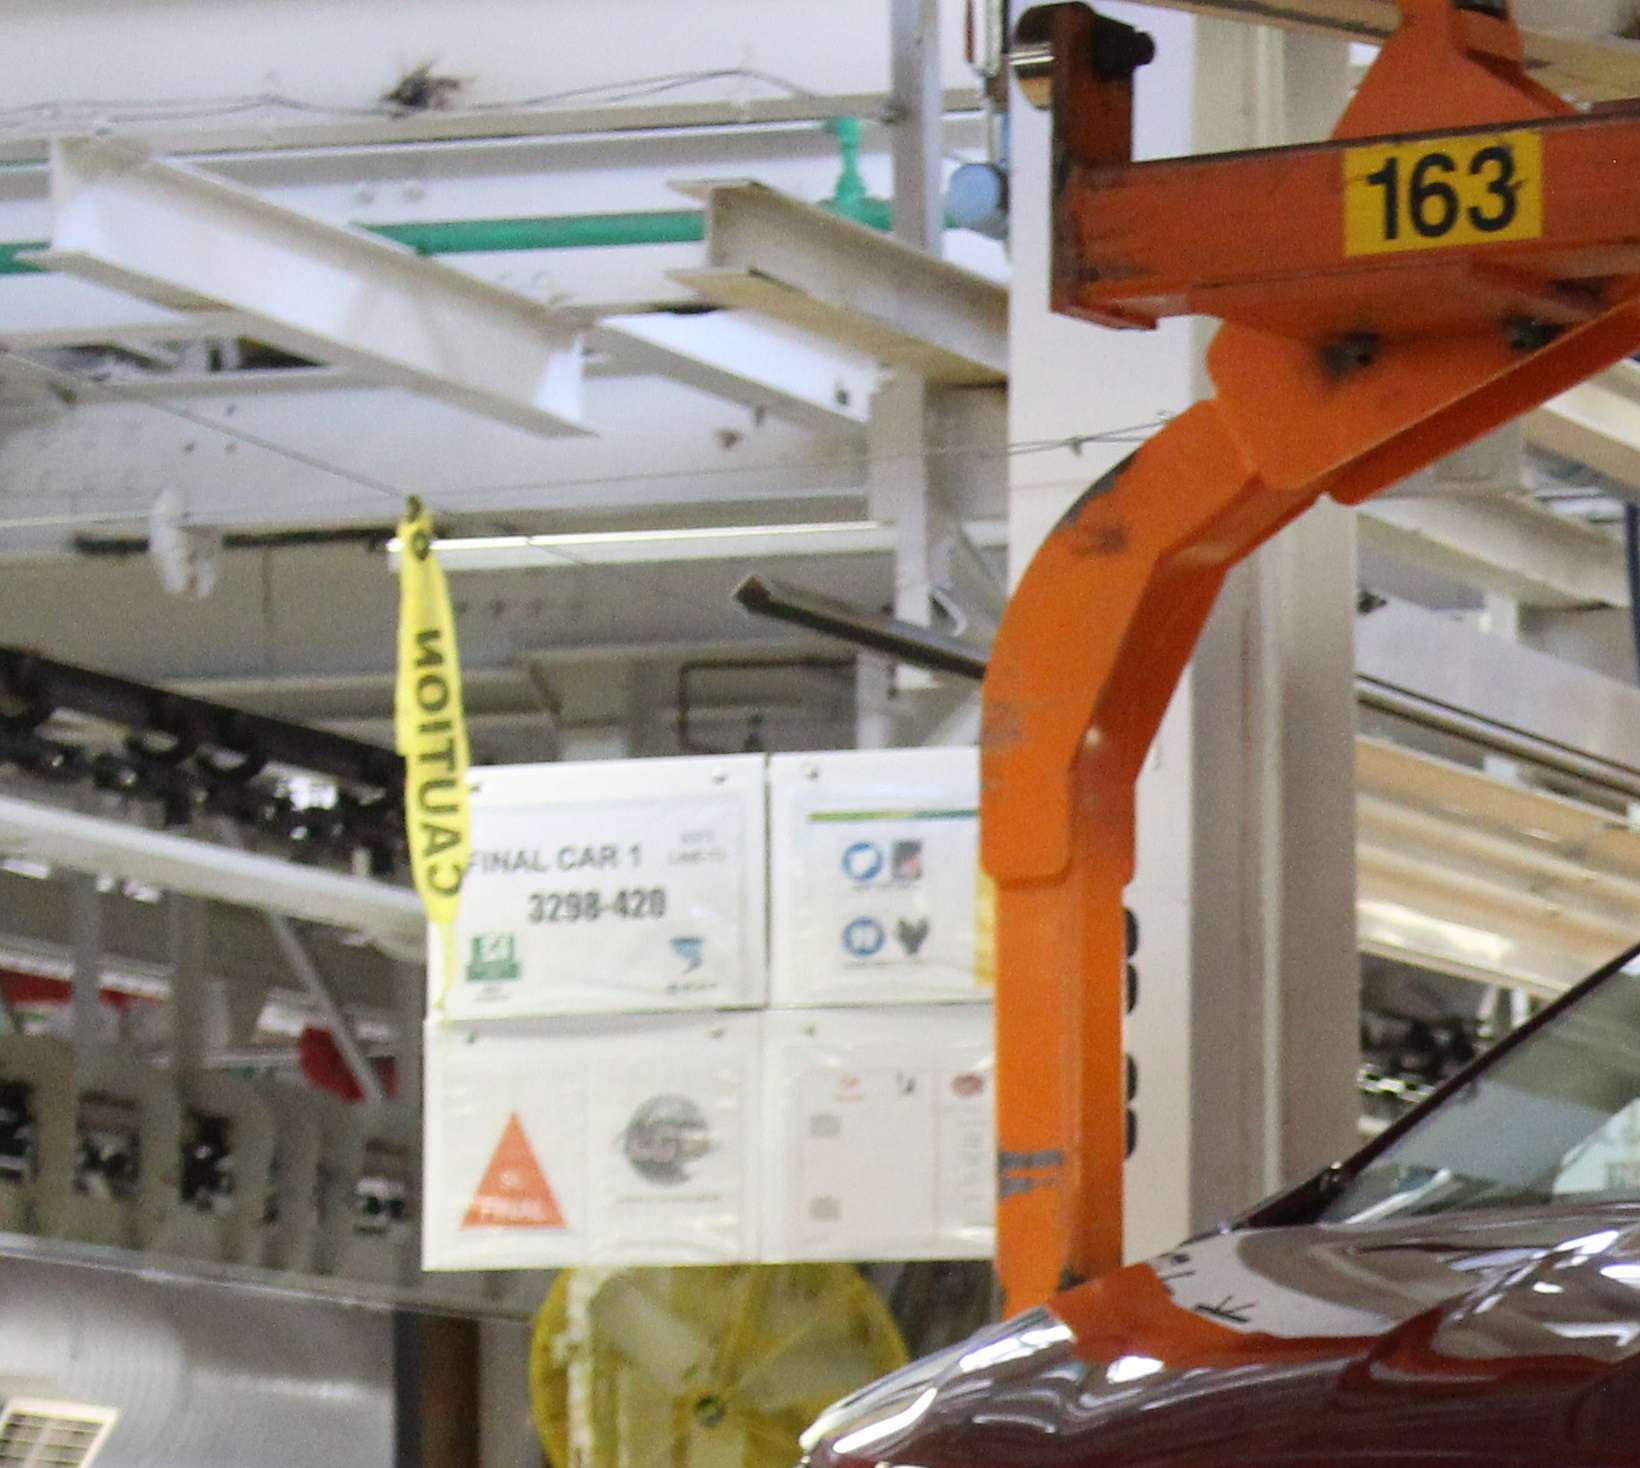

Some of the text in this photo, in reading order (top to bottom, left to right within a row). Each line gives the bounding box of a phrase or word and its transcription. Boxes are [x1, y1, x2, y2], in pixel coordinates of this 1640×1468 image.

[1365, 145, 1517, 240] 163
[556, 844, 618, 871] CAR
[629, 844, 642, 868] 1
